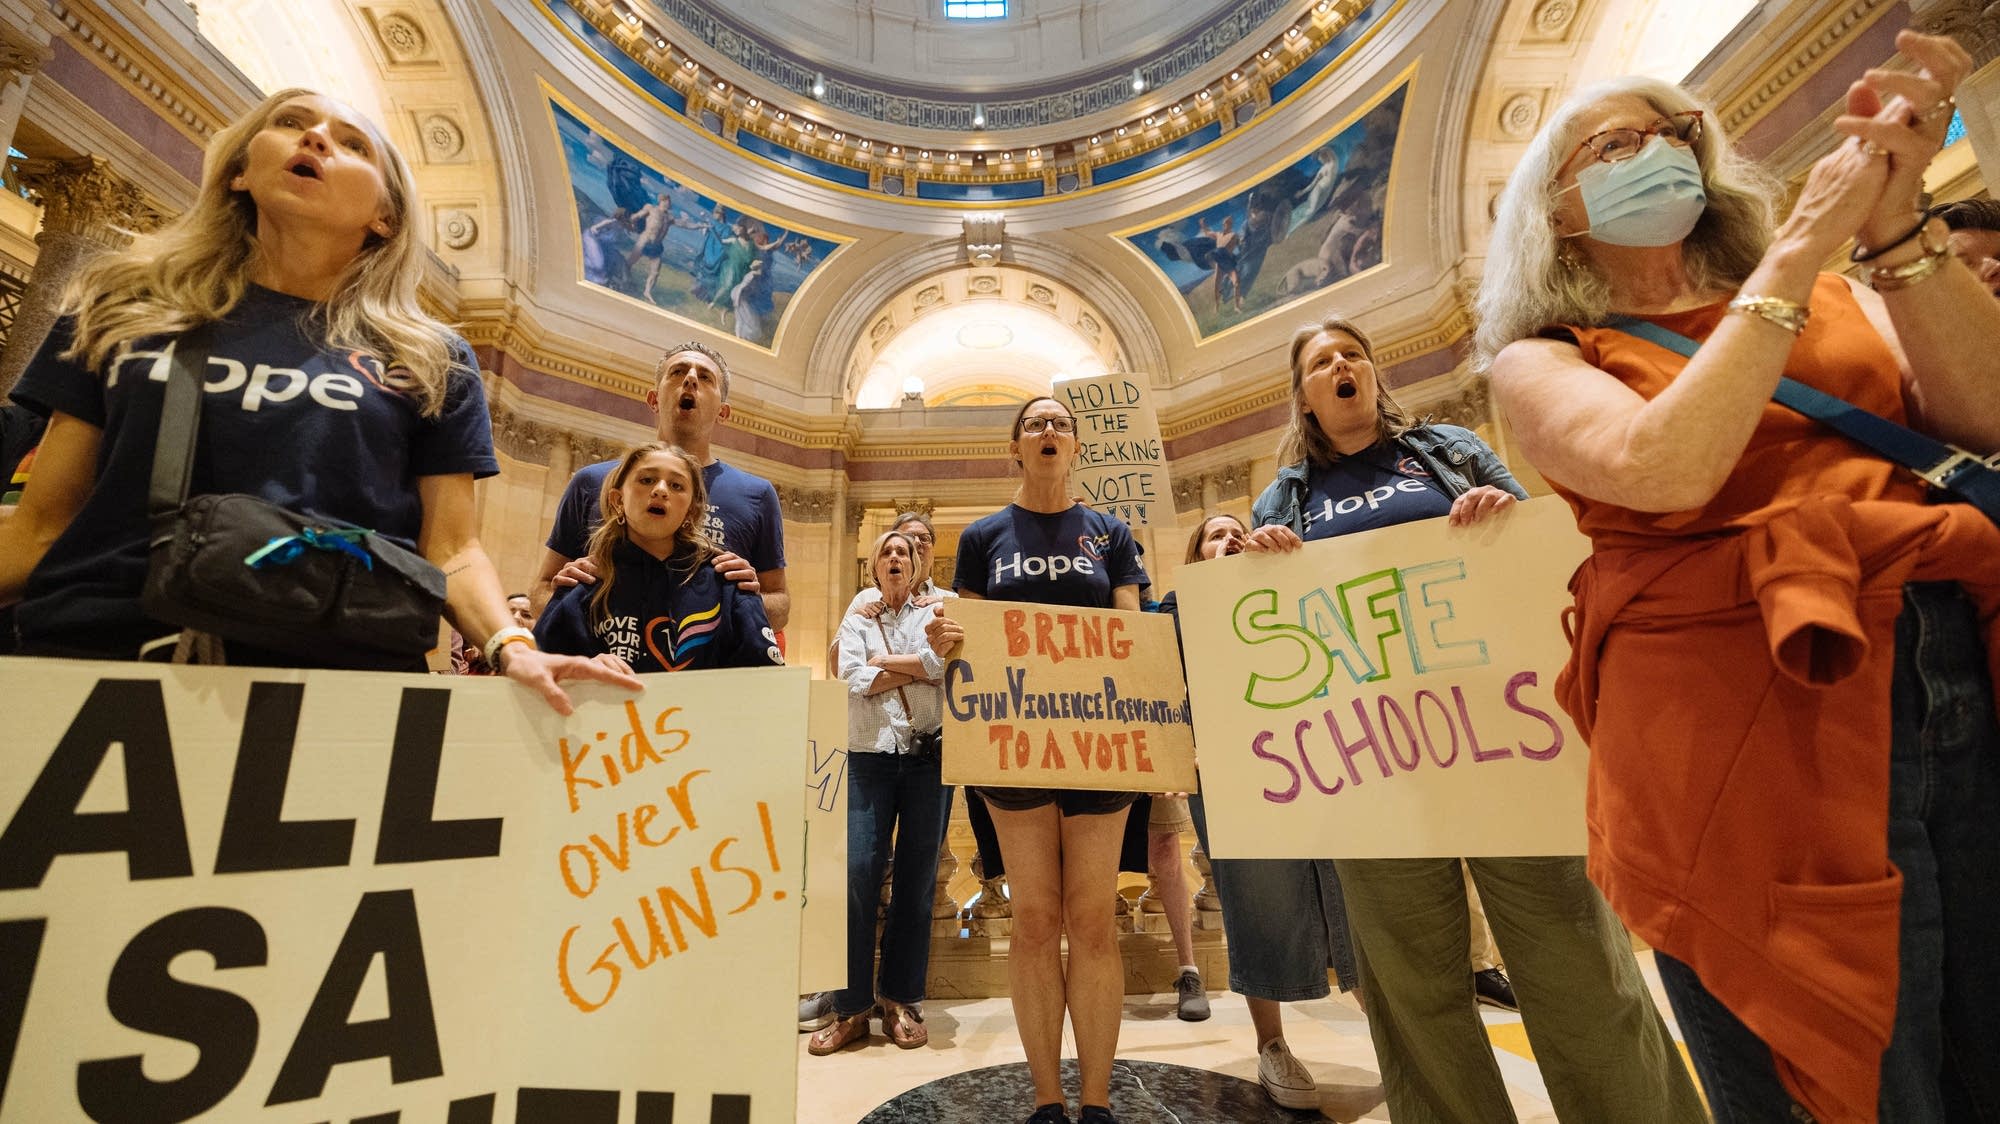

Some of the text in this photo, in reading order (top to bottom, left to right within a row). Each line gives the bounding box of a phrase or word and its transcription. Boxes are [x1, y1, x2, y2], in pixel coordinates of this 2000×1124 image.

[1066, 380, 1140, 409] HOLD
[1085, 413, 1129, 431] THE
[1079, 439, 1161, 465] REAKING
[1081, 472, 1156, 502] VOTE
[1302, 478, 1429, 535] Hope
[995, 551, 1095, 585] Hope
[593, 615, 639, 638] MOVE
[604, 631, 641, 648] OUR
[1003, 609, 1134, 664] BRING
[1231, 557, 1491, 710] SAFE
[989, 725, 1155, 773] TO A VOTE
[1251, 671, 1565, 804] SCHOOLS
[0, 678, 505, 891] ALL
[559, 769, 712, 899] over
[557, 801, 788, 1014] GUNS!
